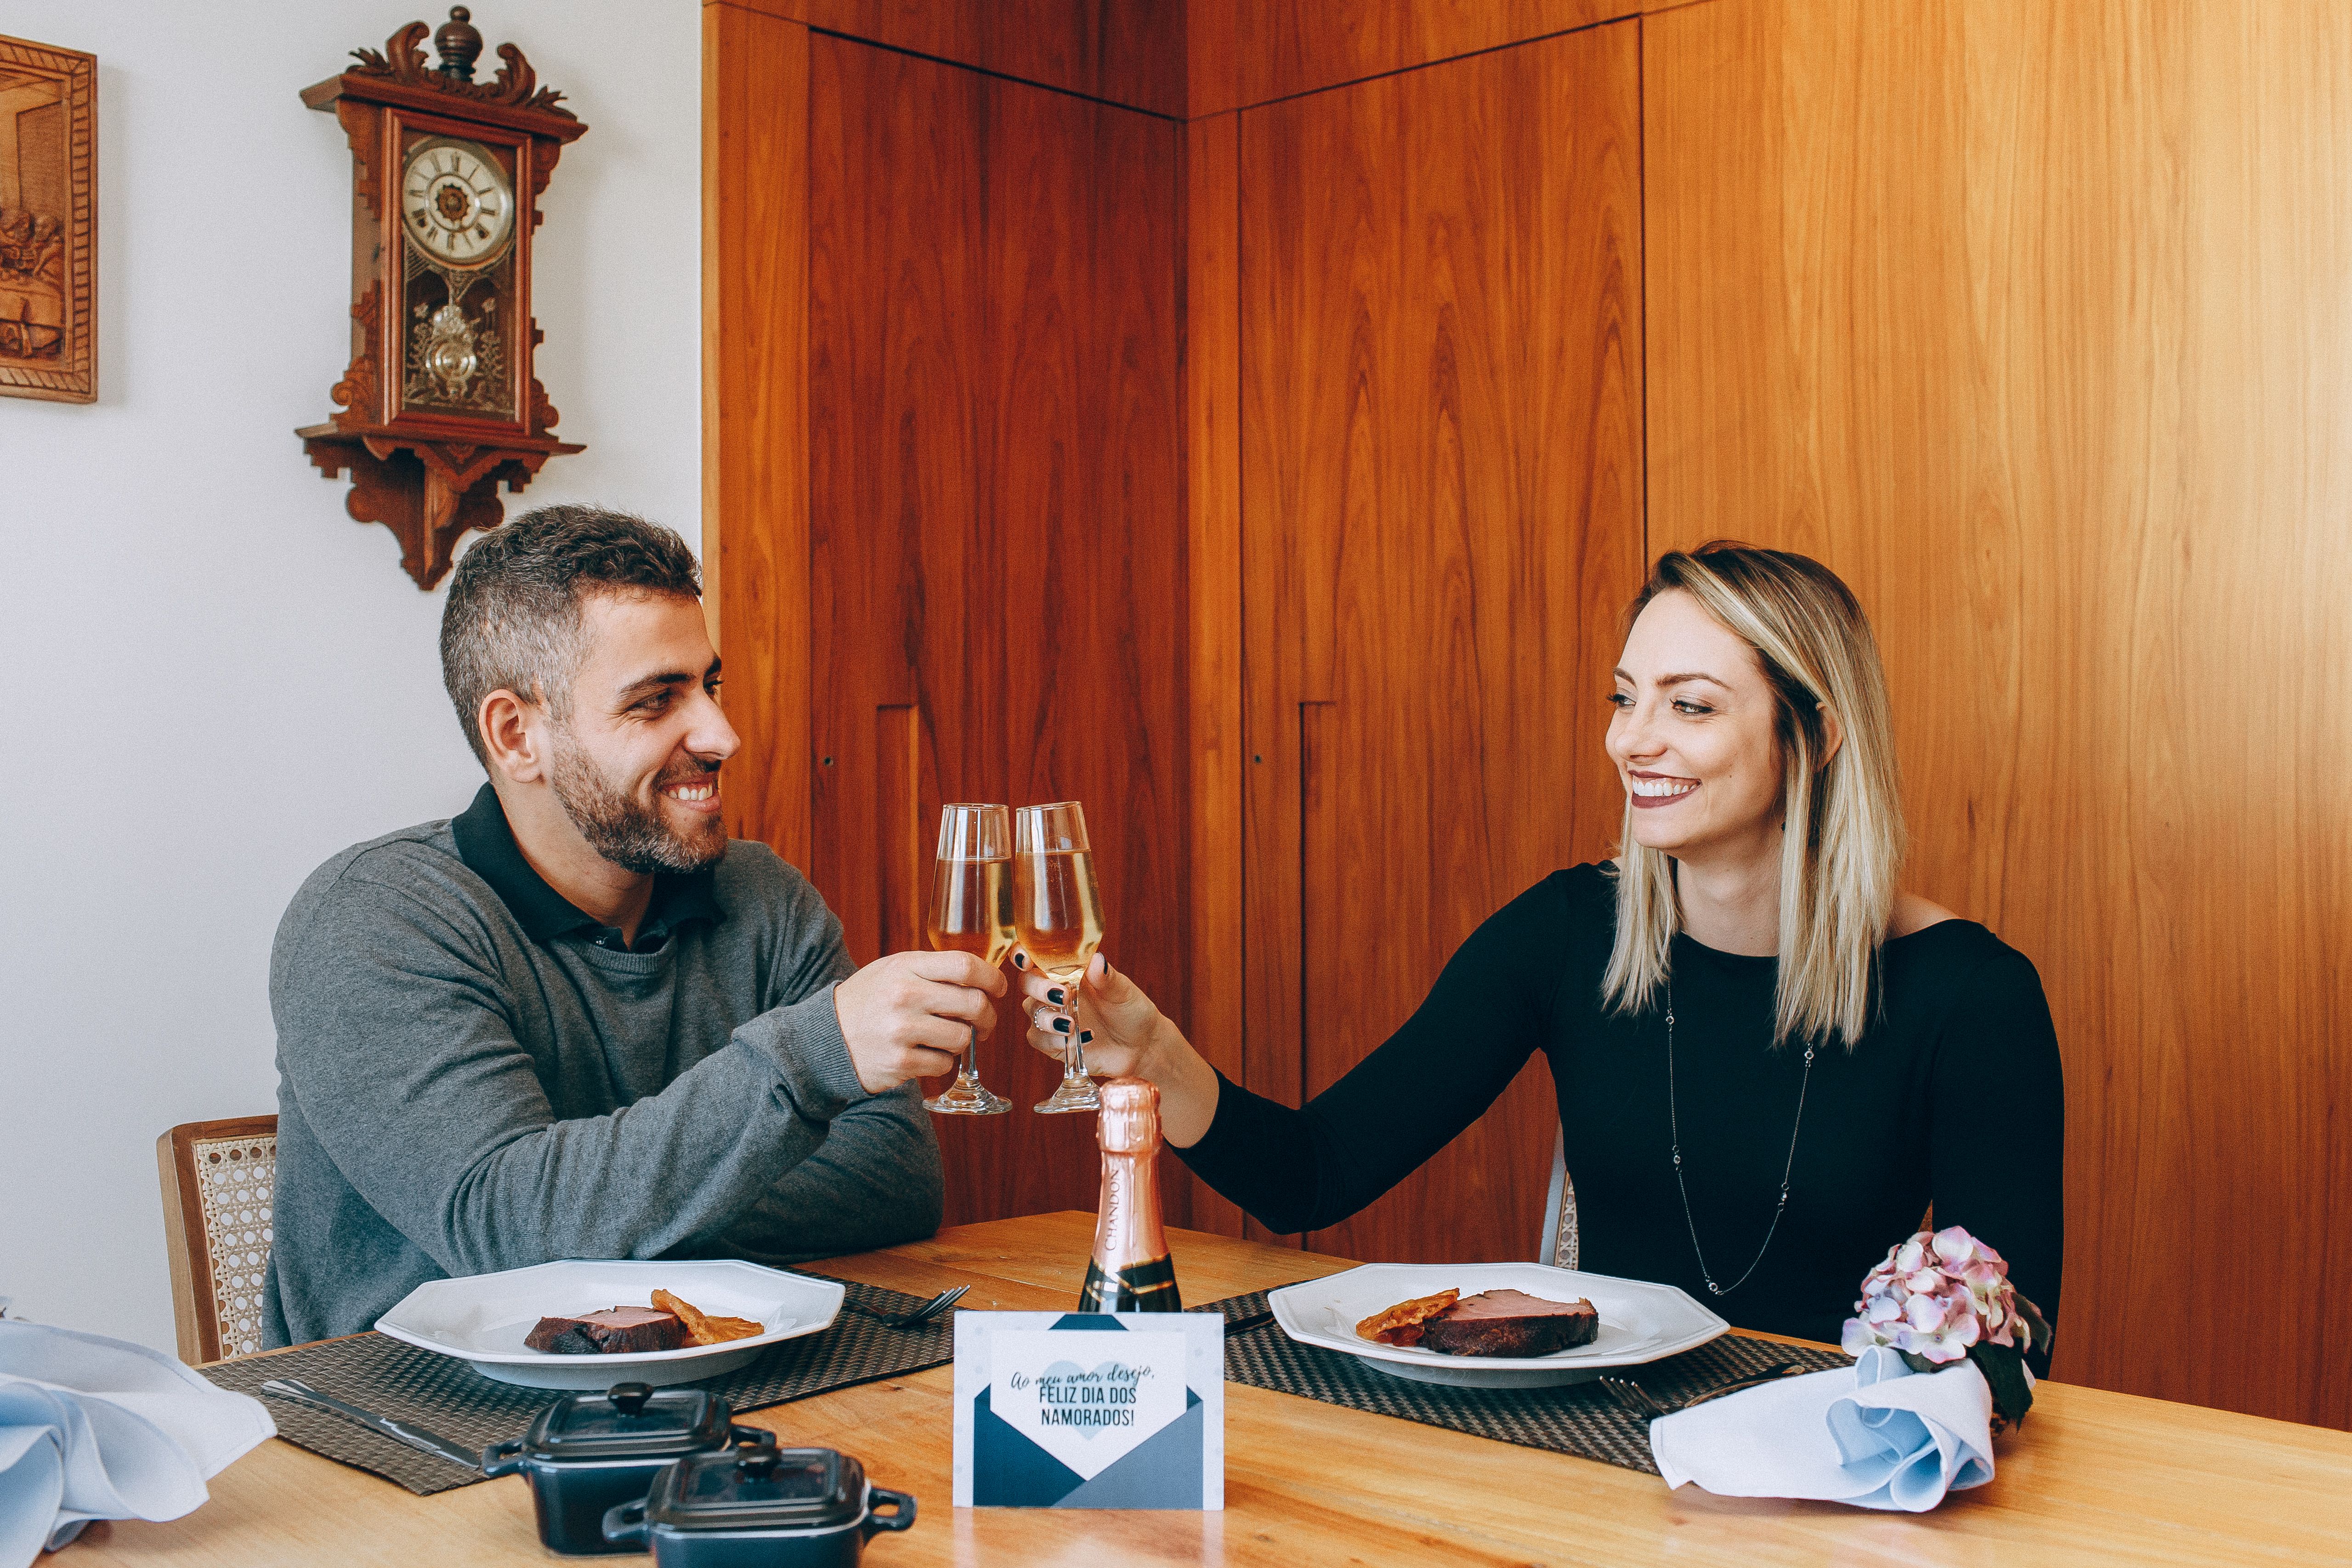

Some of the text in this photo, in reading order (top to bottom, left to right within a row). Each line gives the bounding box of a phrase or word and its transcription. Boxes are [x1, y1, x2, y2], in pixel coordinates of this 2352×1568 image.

[1105, 1169, 1120, 1251] CHANDON
[1011, 1364, 1155, 1390] Ao meu amor desejo,
[1039, 1387, 1137, 1404] FELIZ DIA DOS
[1041, 1409, 1134, 1426] NAMORADOS!
